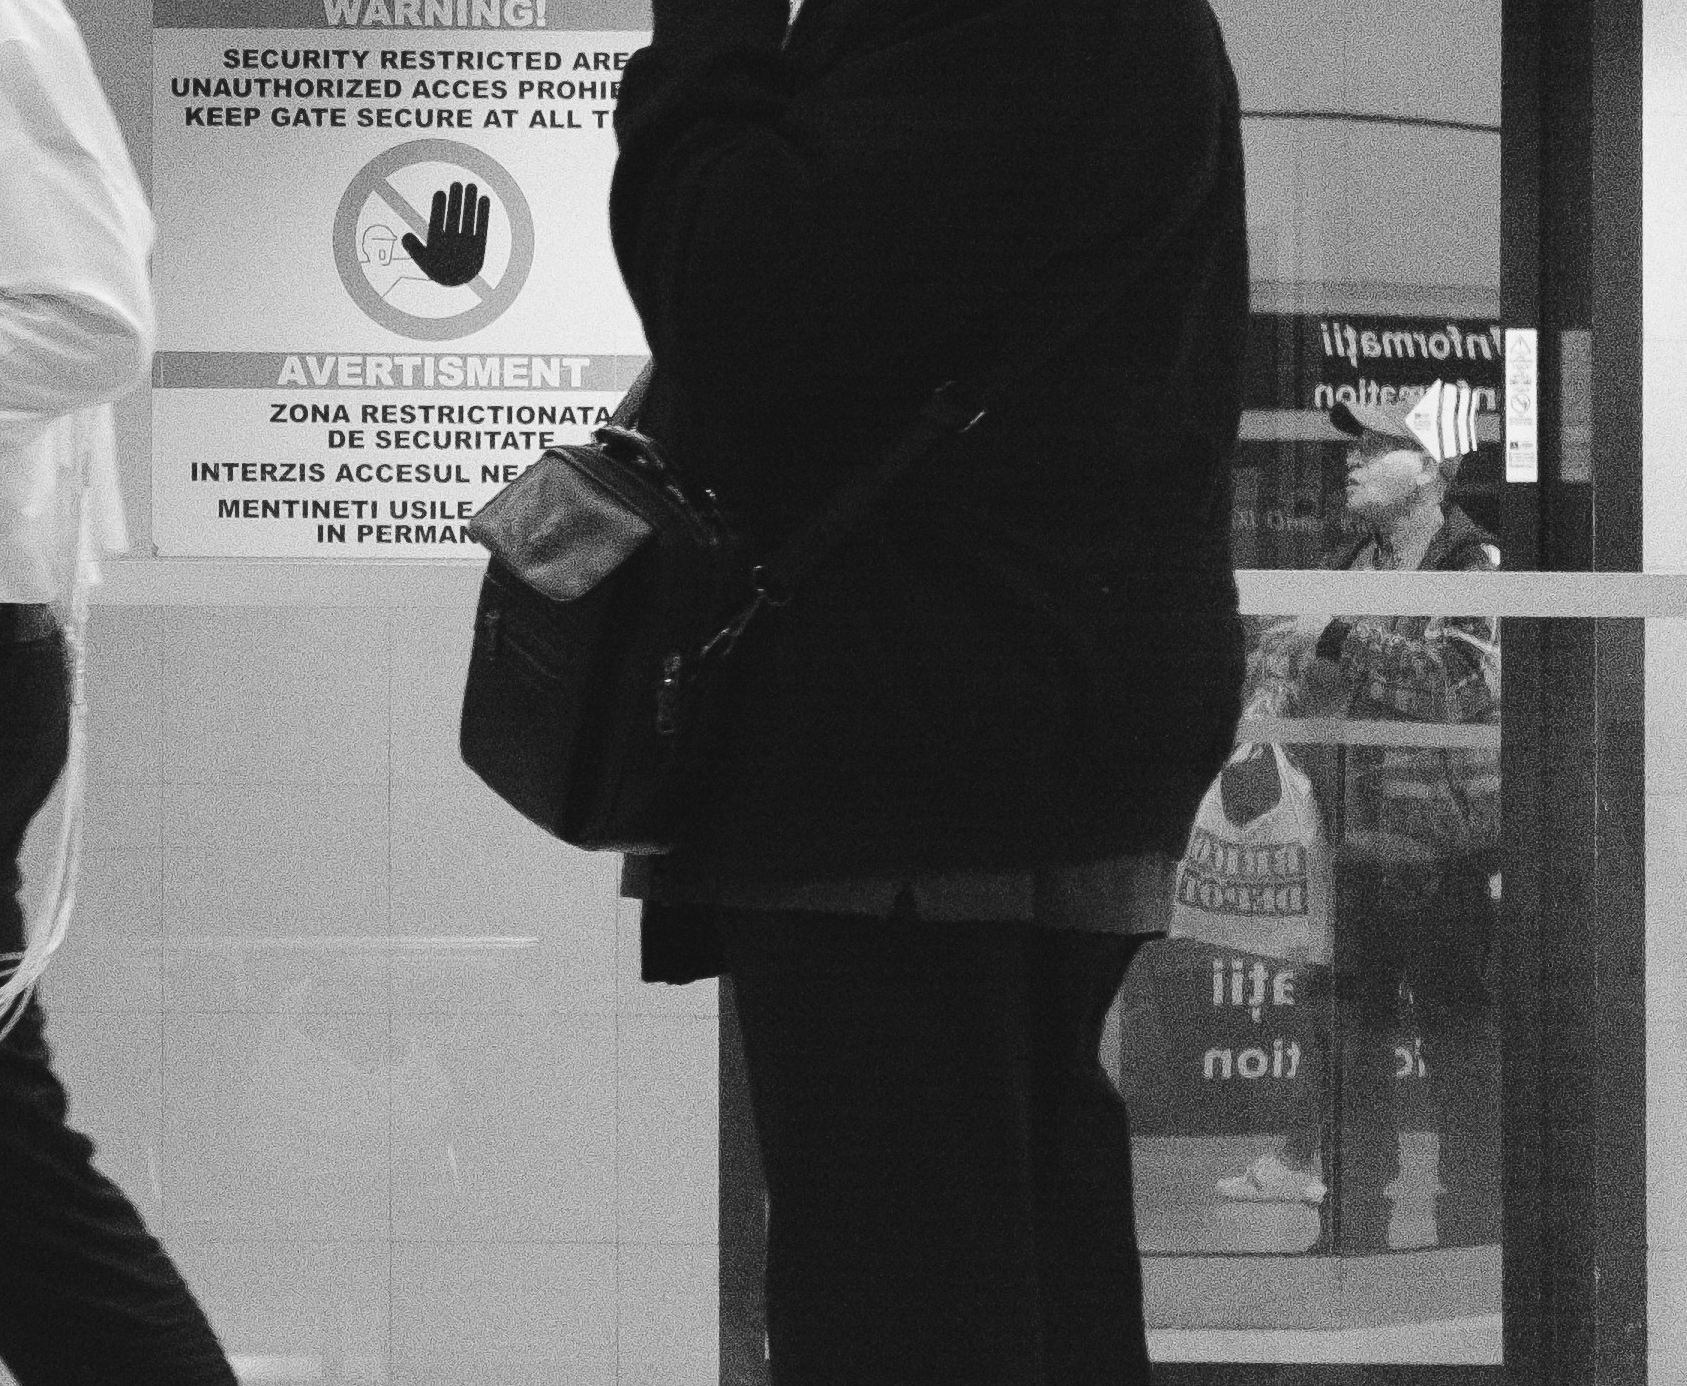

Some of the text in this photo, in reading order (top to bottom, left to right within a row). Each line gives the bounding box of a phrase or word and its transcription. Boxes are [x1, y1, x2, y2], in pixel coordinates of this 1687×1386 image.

[223, 48, 628, 71] SECURITY RESTRICTED ARE
[170, 77, 620, 100] UNAUTHORIZED ACCES PROHI
[184, 106, 261, 128] KEEP
[270, 106, 346, 128] GATE
[357, 107, 472, 129] SECURE
[483, 109, 518, 129] AT
[529, 109, 582, 129] ALL
[276, 355, 590, 387] AVERTISMENT
[269, 403, 611, 425] ZONA RESTRICTIONATA
[328, 429, 555, 450] DE SECURITATE
[190, 461, 518, 484] INTERZIS ACCESUL NE
[218, 498, 473, 520] MENTINETI USILE
[317, 524, 476, 544] IN PERMAN
